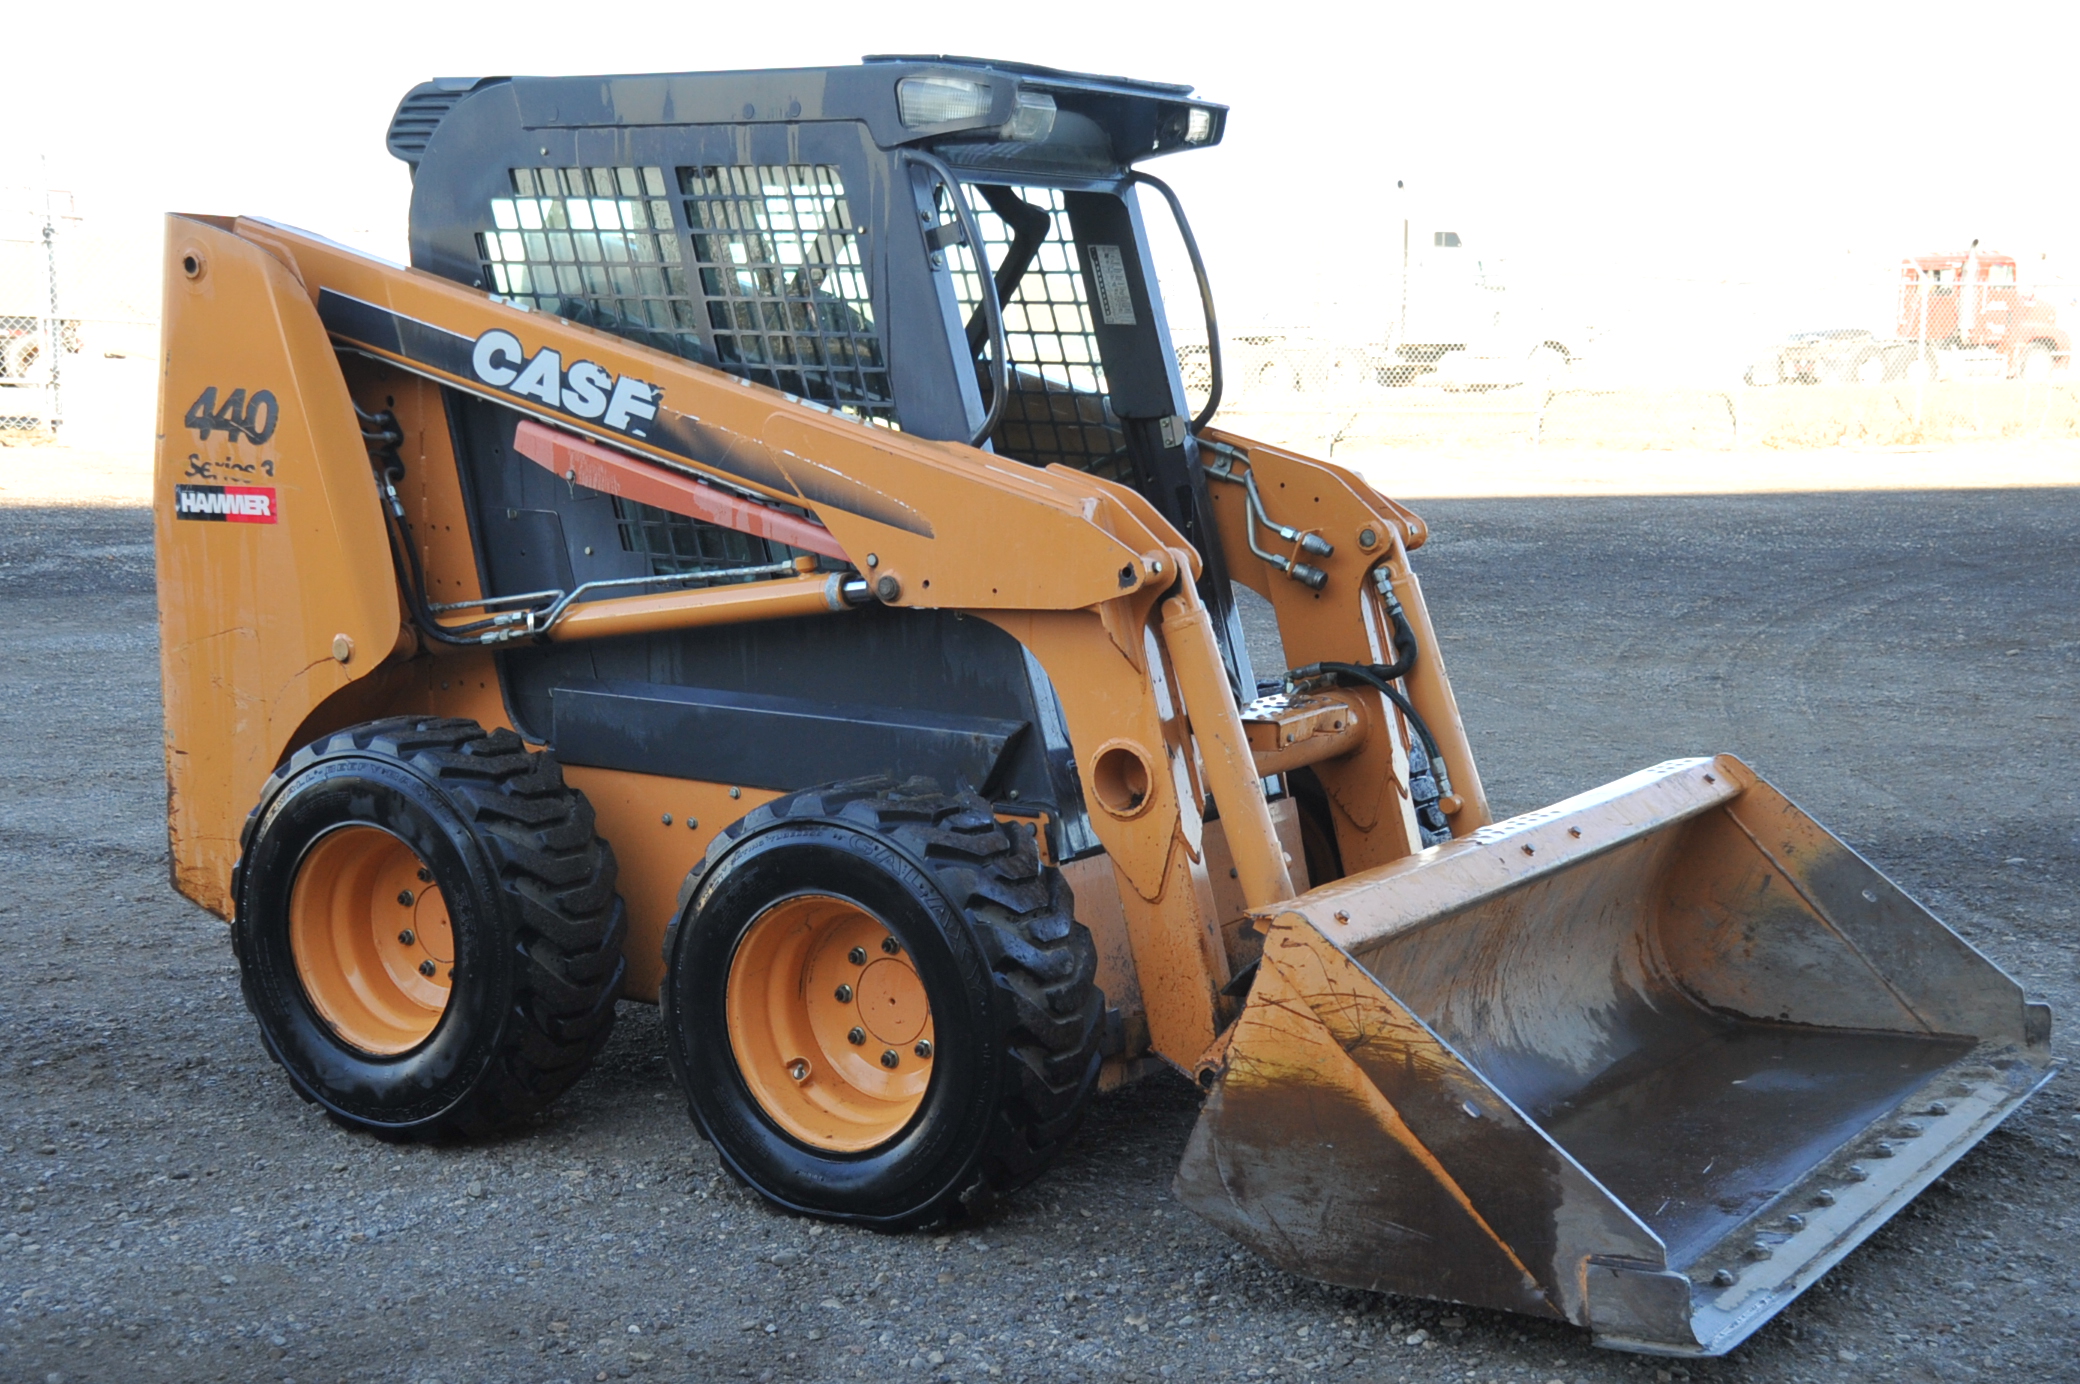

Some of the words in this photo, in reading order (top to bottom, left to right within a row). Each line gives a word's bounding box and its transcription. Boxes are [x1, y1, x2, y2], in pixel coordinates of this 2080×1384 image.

[184, 386, 279, 446] 440
[473, 329, 657, 438] CASE
[181, 491, 271, 517] HAMMER
[848, 833, 987, 995] GALAXY
